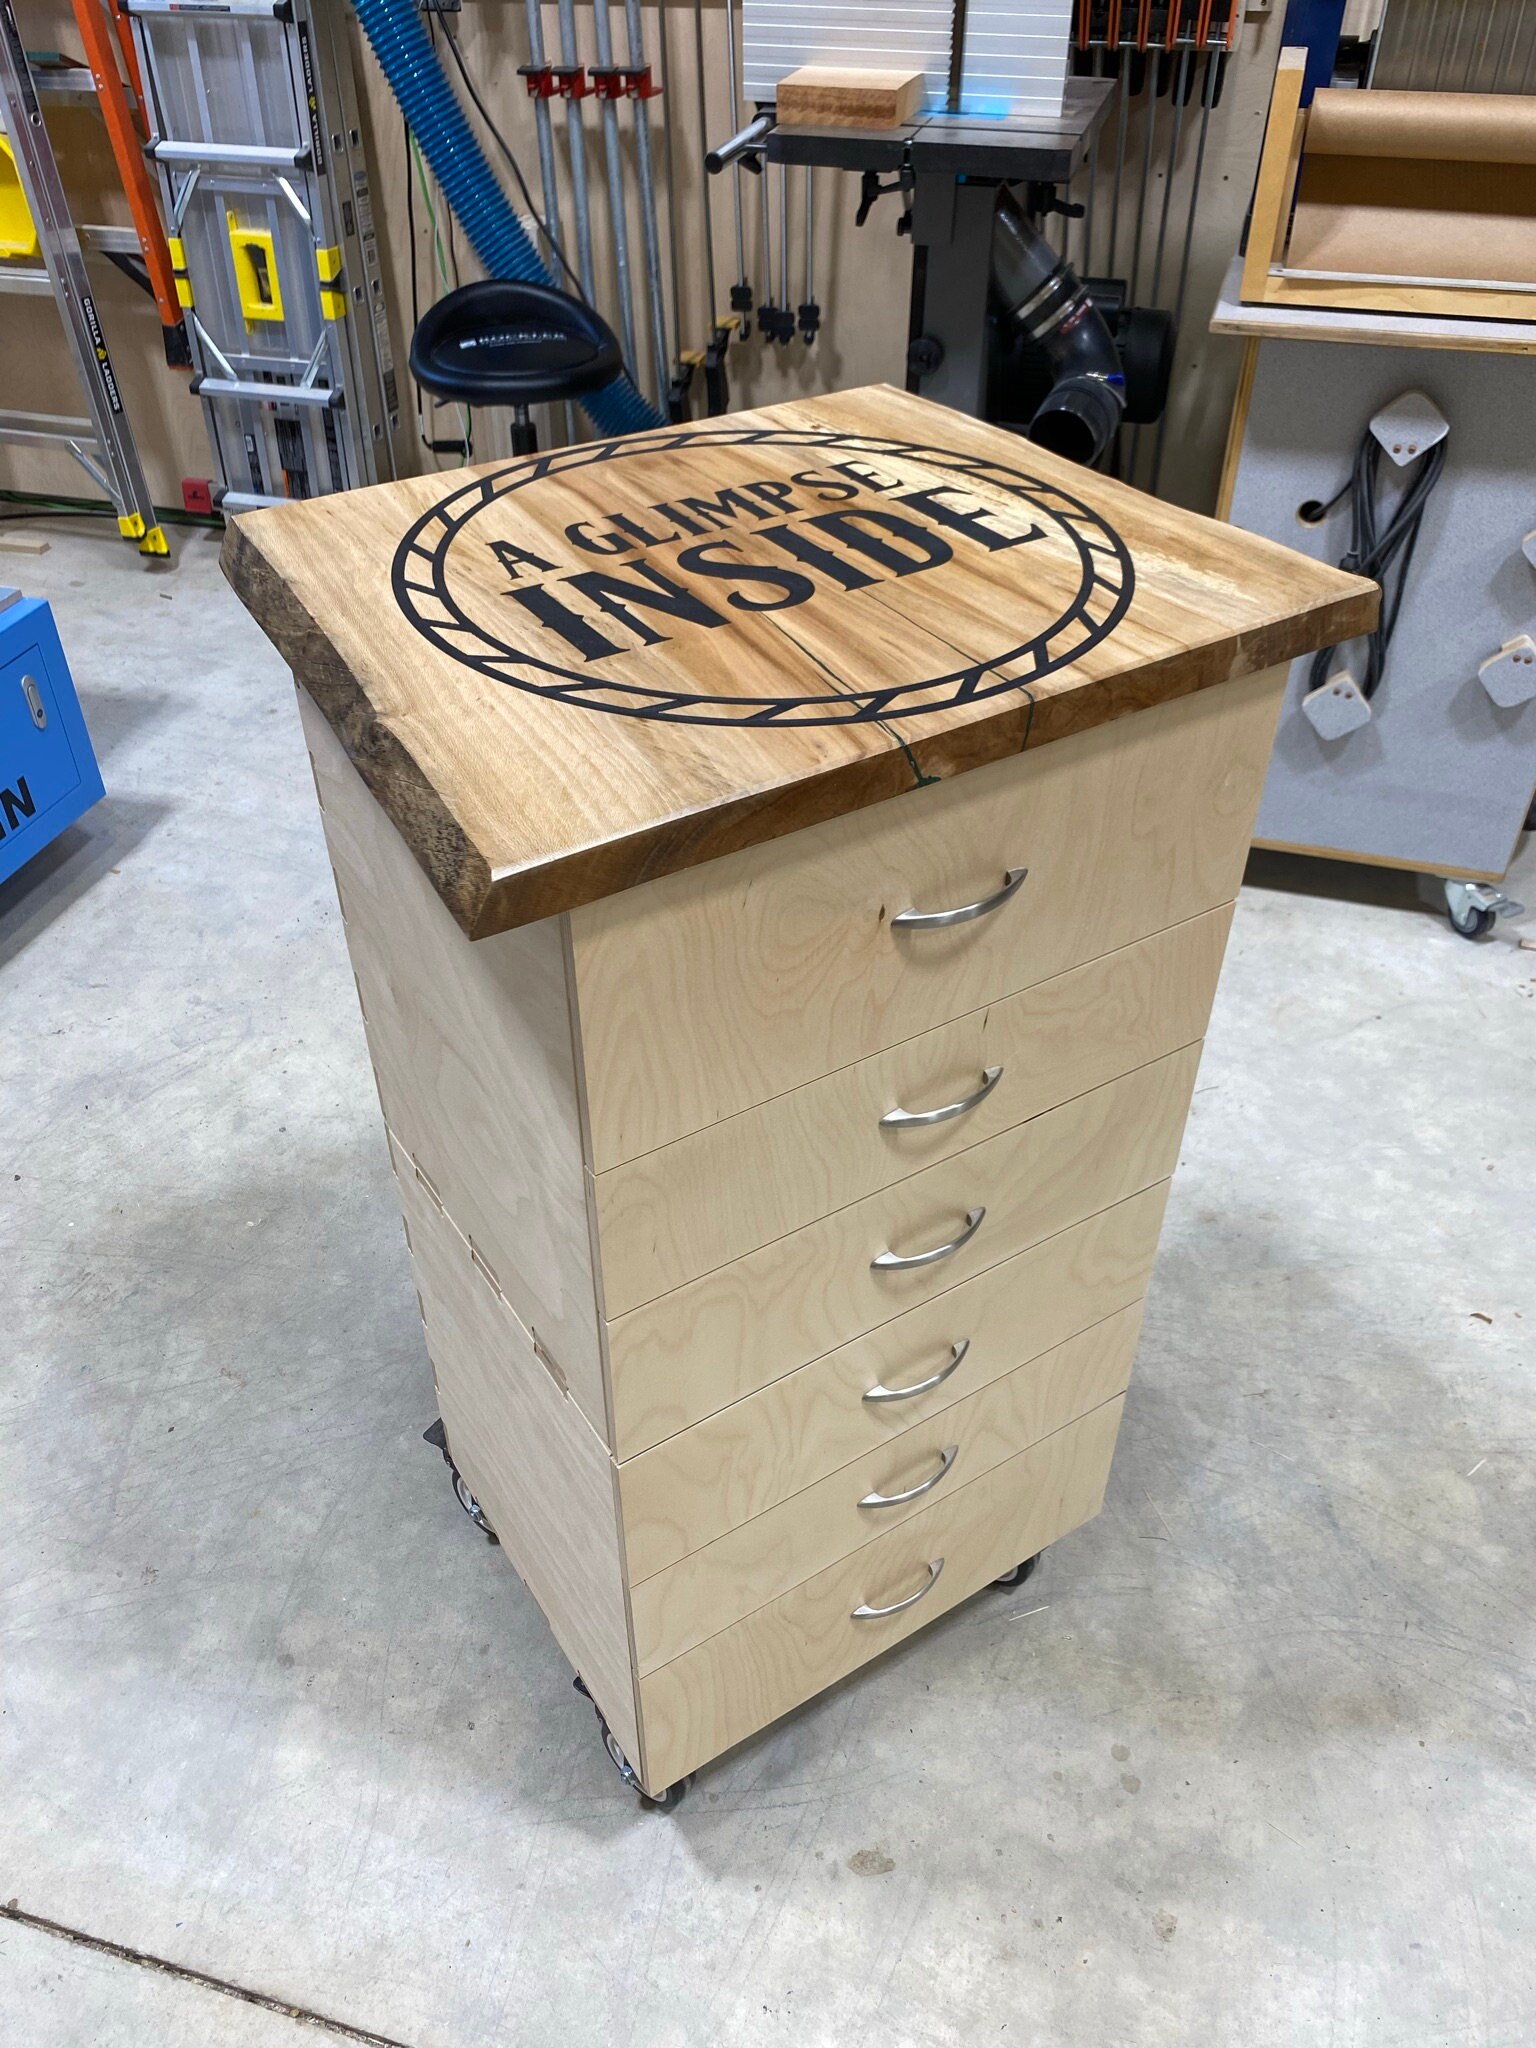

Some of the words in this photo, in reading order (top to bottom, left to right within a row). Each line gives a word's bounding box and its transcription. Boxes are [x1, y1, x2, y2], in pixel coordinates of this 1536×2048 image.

[301, 36, 314, 93] LADDERS
[312, 114, 323, 165] GORILLA
[83, 297, 101, 346] GORILLA
[102, 361, 120, 411] LADDERS
[486, 540, 563, 580] A
[564, 460, 905, 555] GLIMPSE
[501, 486, 1048, 662] INSIDE
[0, 775, 37, 840] N
